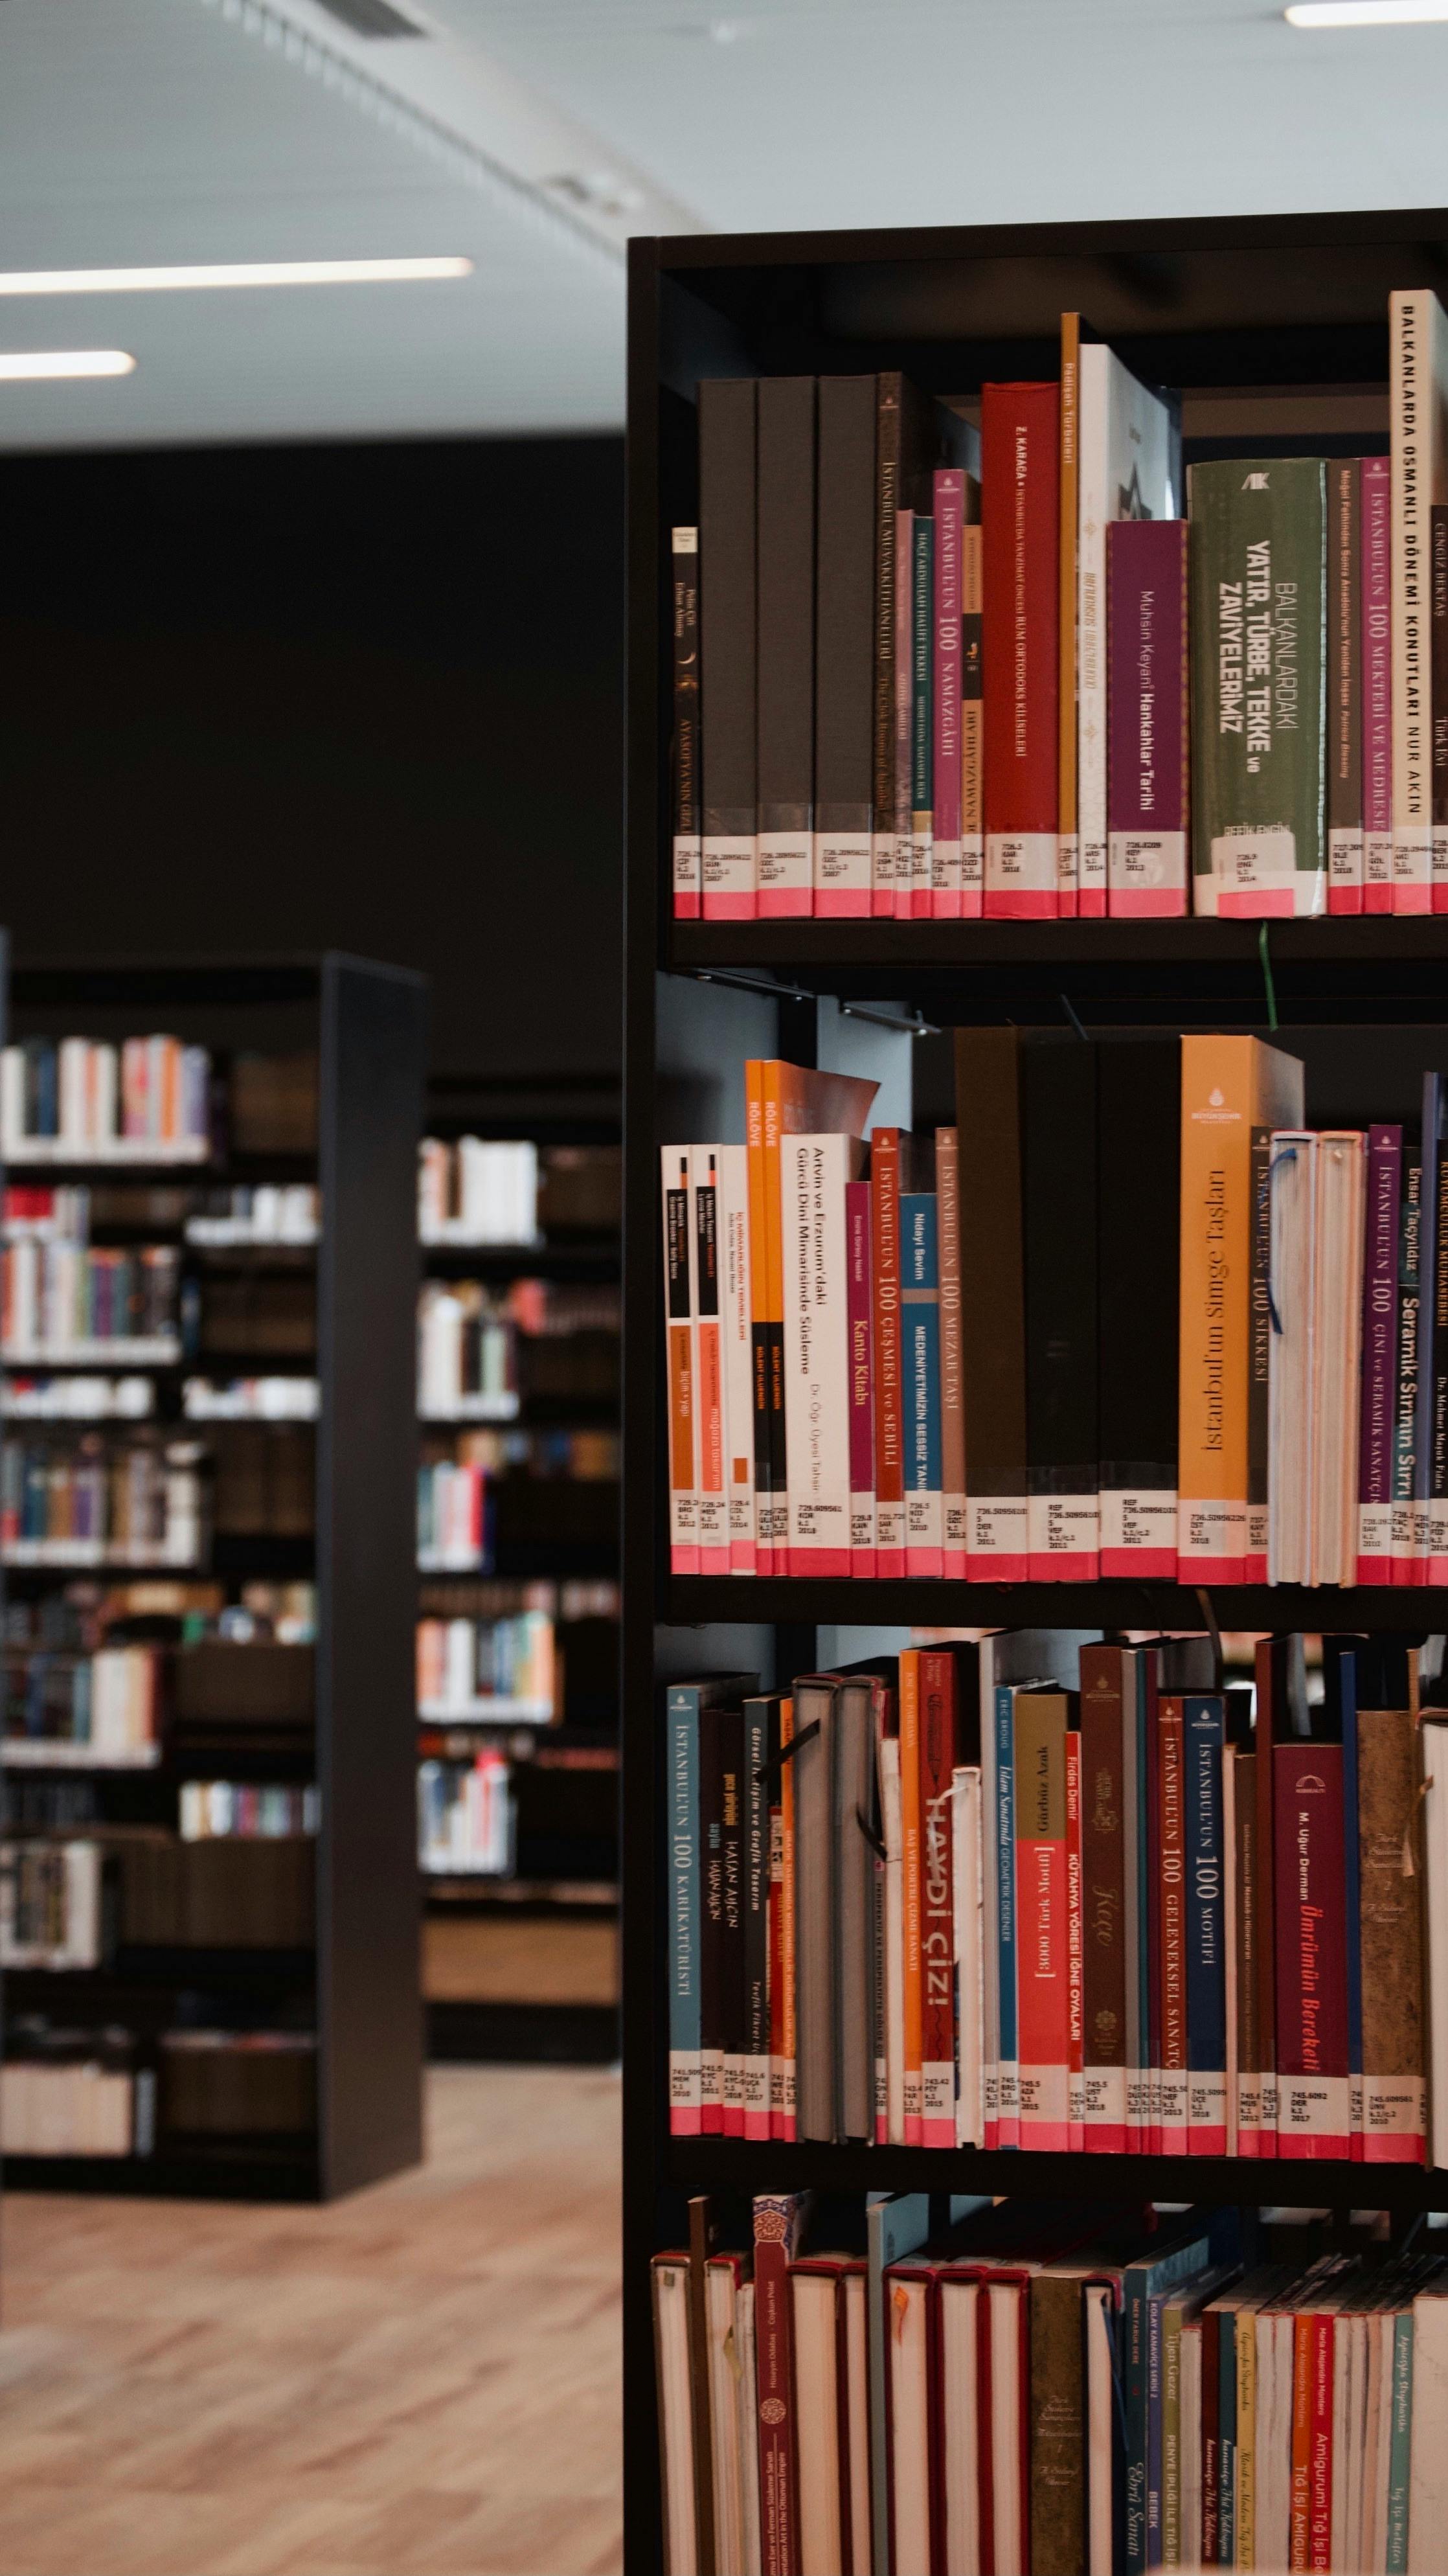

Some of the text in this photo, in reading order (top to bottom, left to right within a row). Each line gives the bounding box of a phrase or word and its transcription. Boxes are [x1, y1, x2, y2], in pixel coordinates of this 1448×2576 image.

[881, 462, 896, 523] İSTANBUL
[1372, 493, 1388, 595] İSTANBUL'UN
[1402, 306, 1422, 813] BALKANLARDA OSMANLI DÖNEMİ KONUTLARI NUR AKIN
[1435, 523, 1448, 568] CENGİZ
[939, 508, 958, 757] İSTANBUL'UN 100 NAMAZGÂHI
[1015, 617, 1026, 639] RUM
[1139, 591, 1155, 639] Muhsin
[1369, 604, 1388, 637] 100
[1015, 642, 1026, 698] ORTODOKS
[1219, 583, 1243, 733] ZAVİYELERİMİZ
[1245, 540, 1275, 772] YATIR, TÜRBE, TEKKE ve
[1275, 583, 1299, 728] BALKANLARDAKİ
[1372, 647, 1388, 717] MEKTEBİ
[1015, 702, 1028, 756] KİLİSELERİ
[1139, 693, 1155, 766] Hankahlar
[1372, 725, 1385, 744] VE
[1435, 718, 1447, 745] Türk
[1139, 769, 1155, 810] Tarihi
[749, 1101, 762, 1146] RÖLÖVE
[765, 1101, 778, 1146] RÖLÖVE
[813, 1148, 827, 1305] Artvin ve Erzurum'daki
[880, 1168, 894, 1268] İSTANBUL'UN
[1205, 1170, 1228, 1243] Taşları
[1376, 1167, 1394, 1268] İSTANBUL'UN
[1405, 1168, 1422, 1270] Ensar Taçyıldız
[797, 1148, 811, 1374] Gürcü Dini Mimarisinde Süsleme
[912, 1213, 925, 1279] Nidayi Sevim
[878, 1276, 897, 1310] 100
[942, 1166, 960, 1409] İSTANBUL'UN 100 MEZAR TAŞI
[1205, 1250, 1229, 1317] Simge
[1372, 1277, 1392, 1312] 100
[855, 1321, 869, 1406] Kanto Kitabı
[881, 1317, 898, 1386] ÇEŞMESİ
[1401, 1297, 1420, 1375] Seramik
[884, 1394, 893, 1408] ve
[915, 1327, 928, 1420] MEDENİYETİMİZİN
[1372, 1376, 1386, 1435] SERAMİK
[916, 1423, 929, 1461] SESSİZ
[1436, 1395, 1447, 1431] Mehmet
[1397, 1454, 1416, 1495] Sırrı
[1068, 1757, 1078, 1820] Firdes Demir
[1165, 1738, 1180, 1840] İSTANBUL'UN
[673, 1726, 692, 1995] İSTANBUL'UN 100 KARİKATÜRİSTİ
[1162, 1849, 1181, 1882] 100
[1195, 1744, 1219, 1965] İSTANBUL'UN 100 MOTİFİ
[1297, 1812, 1310, 1900] M. Uğur Derman
[922, 1798, 953, 2005] HAYDİ ÇİZ!
[1037, 1899, 1050, 1930] Türk
[1069, 1854, 1081, 2040] KÜTAHYA YÖRESİ İĞNE OYALARI
[1165, 1895, 1179, 2002] GELENEKSEL
[1301, 1999, 1320, 2071] Bereketi
[1149, 2303, 1158, 2327] KOLAY
[1166, 2435, 1177, 2470] PENYE
[1313, 2433, 1329, 2507] Amigurumi
[1148, 2491, 1159, 2528] BEBEK
[1166, 2508, 1179, 2524] İLE
